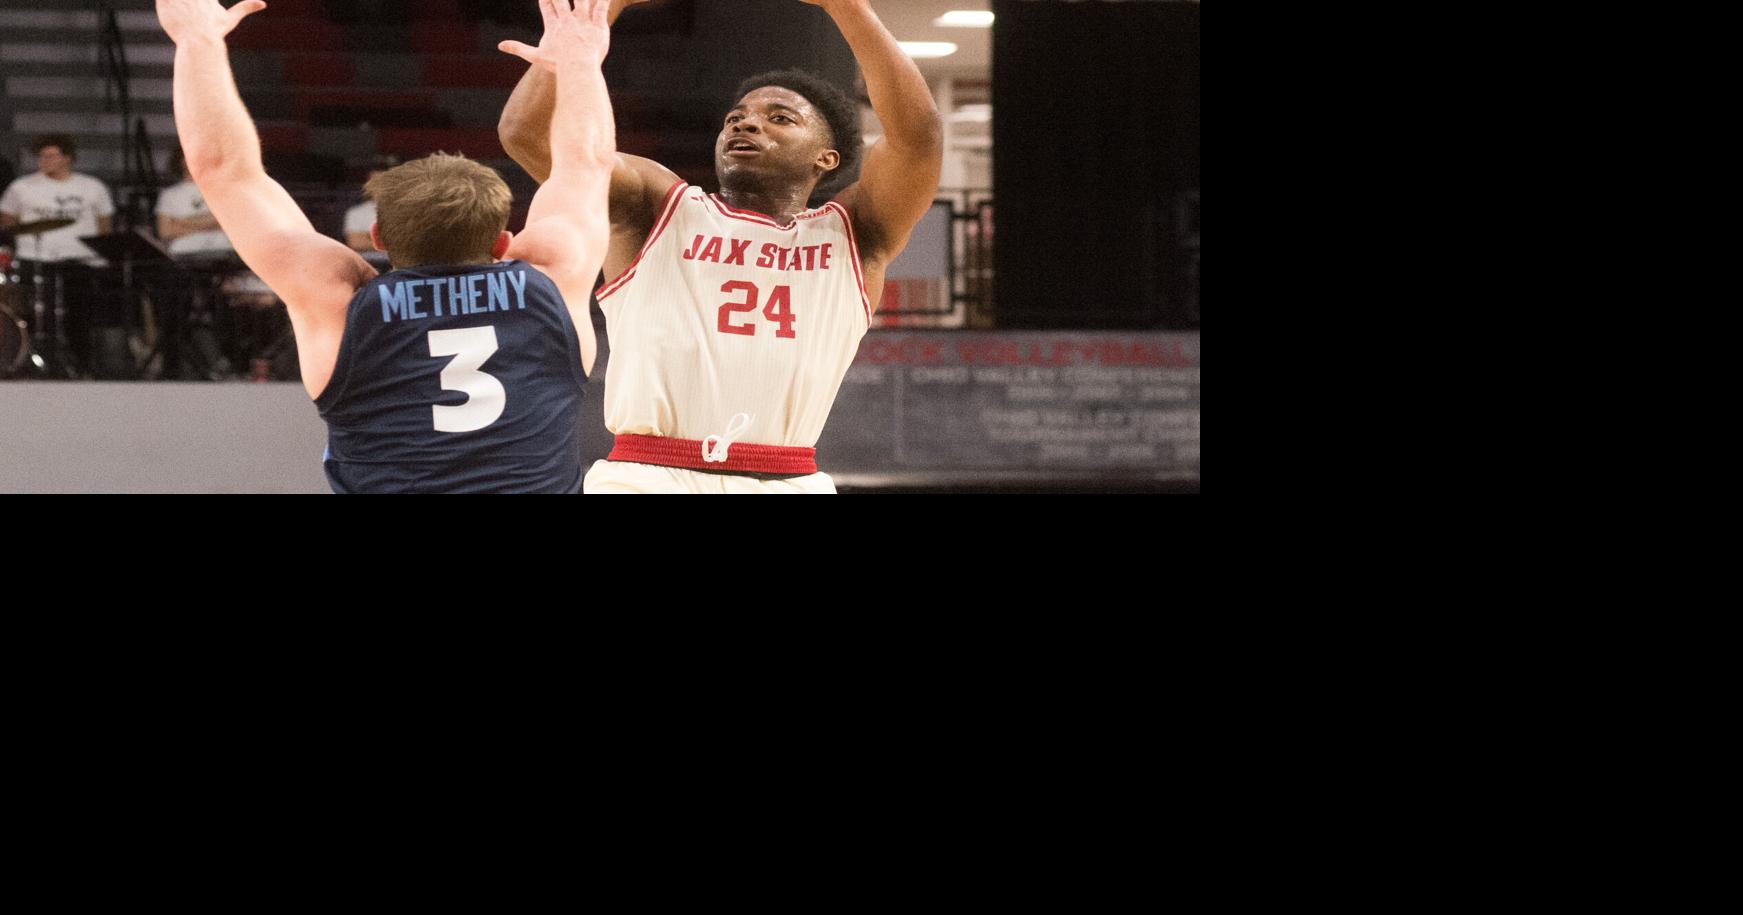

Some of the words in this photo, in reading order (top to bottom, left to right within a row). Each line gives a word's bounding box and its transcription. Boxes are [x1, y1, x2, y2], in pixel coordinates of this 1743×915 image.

[682, 234, 752, 266] JAX
[756, 243, 832, 271] STATE
[378, 270, 527, 323] METHENY
[717, 280, 796, 339] 24
[427, 325, 506, 433] 3
